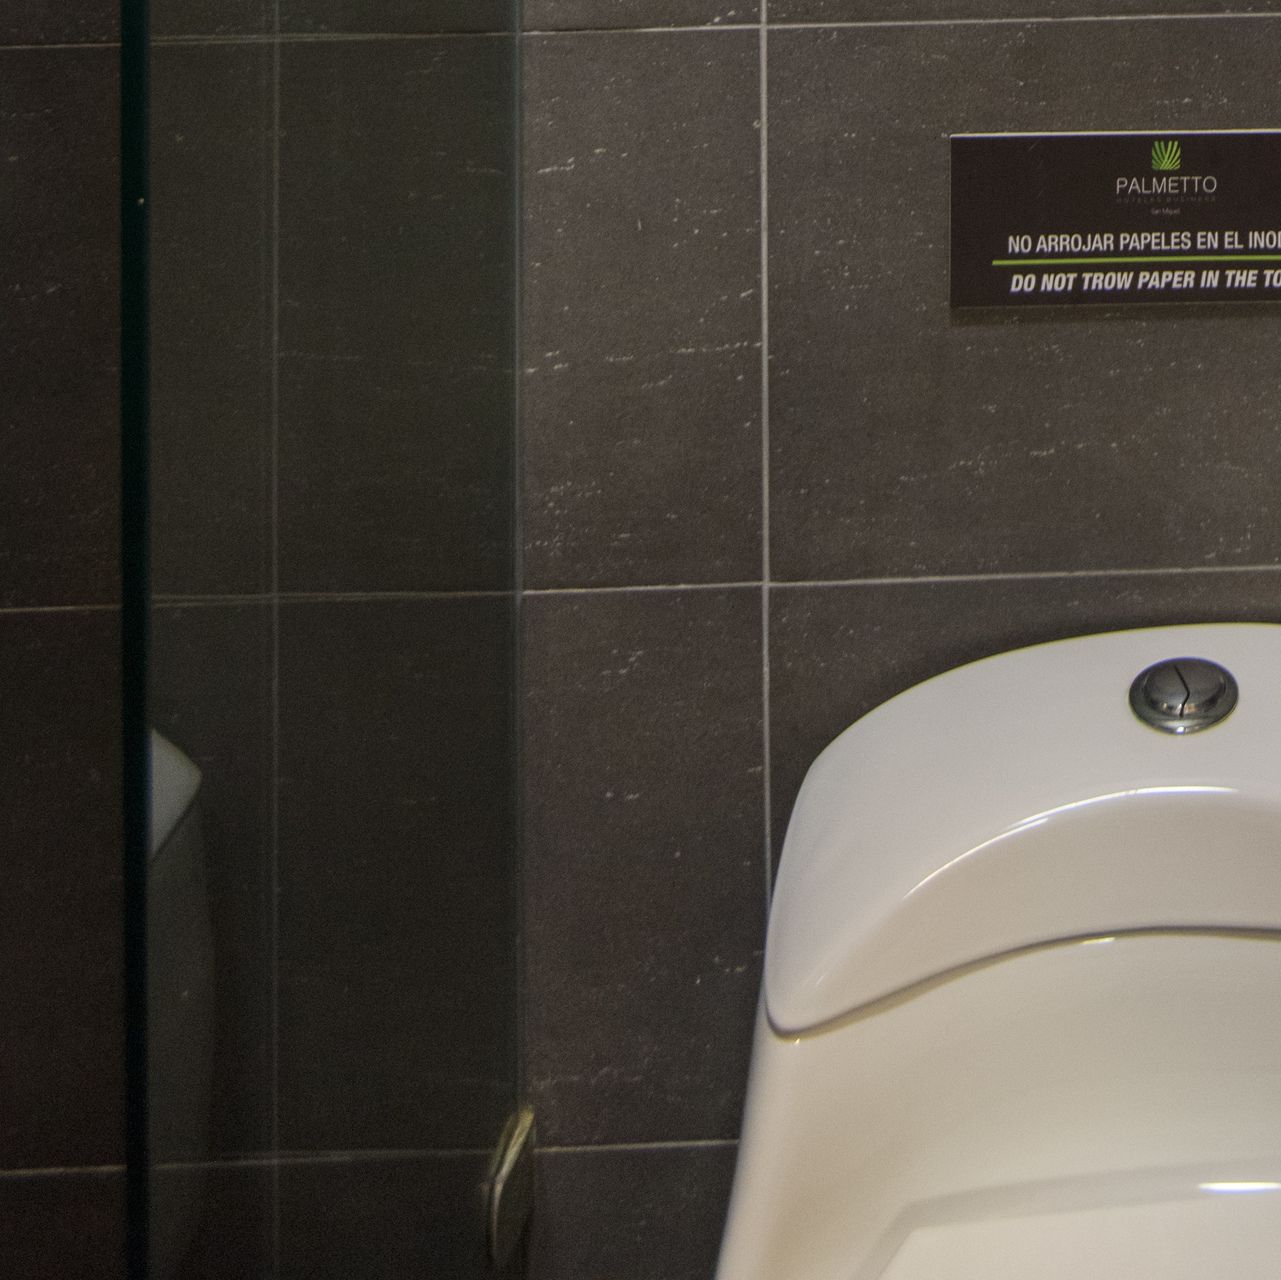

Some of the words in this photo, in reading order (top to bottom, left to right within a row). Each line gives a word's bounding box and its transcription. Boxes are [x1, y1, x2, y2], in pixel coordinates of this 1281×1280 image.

[1116, 175, 1218, 195] PALMETTO
[1008, 234, 1032, 254] NO
[1036, 233, 1115, 253] ARROJAR
[1119, 231, 1192, 251] PAPELES
[1196, 231, 1219, 250] EN
[1224, 230, 1244, 250] EL
[1010, 273, 1036, 293] DO
[1040, 272, 1078, 292] NOT
[1081, 271, 1135, 291] TROW
[1137, 270, 1196, 290] PAPER
[1199, 269, 1220, 289] IN
[1225, 269, 1259, 288] THE
